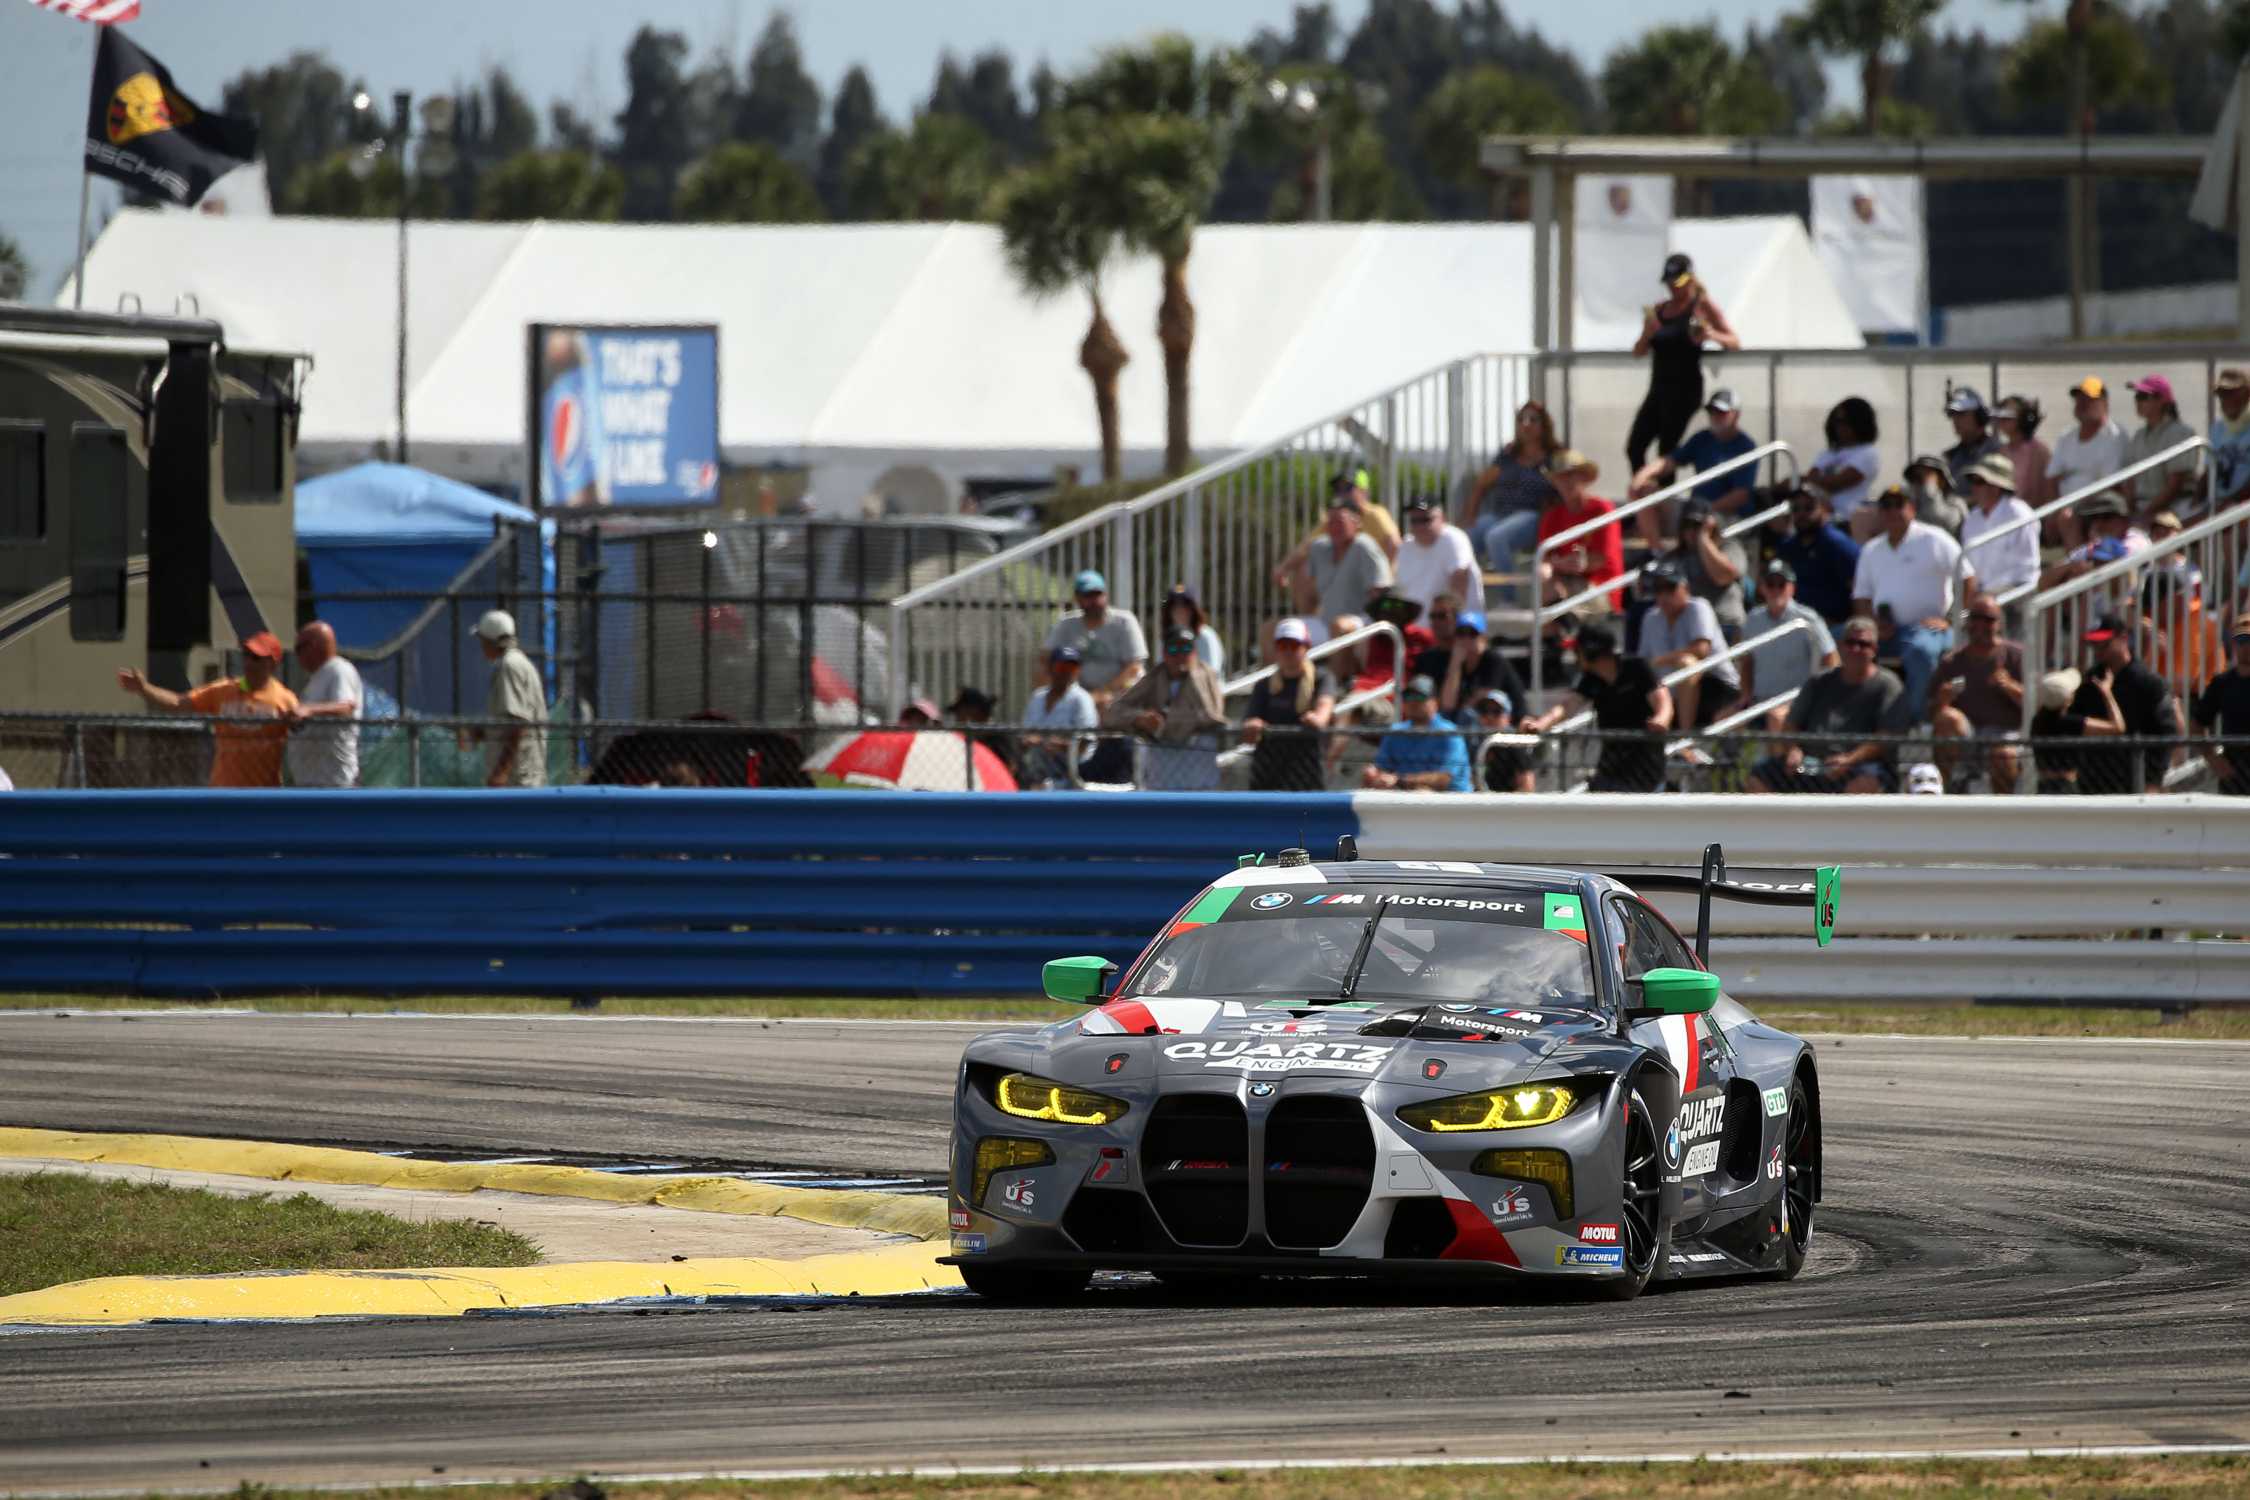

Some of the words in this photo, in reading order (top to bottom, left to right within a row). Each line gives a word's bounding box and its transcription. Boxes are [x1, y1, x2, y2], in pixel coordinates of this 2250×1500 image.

[602, 340, 682, 386] THAT'S
[602, 388, 672, 434] WHAT
[1375, 893, 1526, 914] Motorsport
[1440, 1015, 1531, 1038] Motorsport
[1163, 1041, 1394, 1062] QUARTZ
[1766, 1092, 1785, 1112] GTD
[1680, 1095, 1726, 1144] QUARTZ
[1580, 1226, 1617, 1241] MOTUL
[1580, 1253, 1619, 1263] MICHELIN
